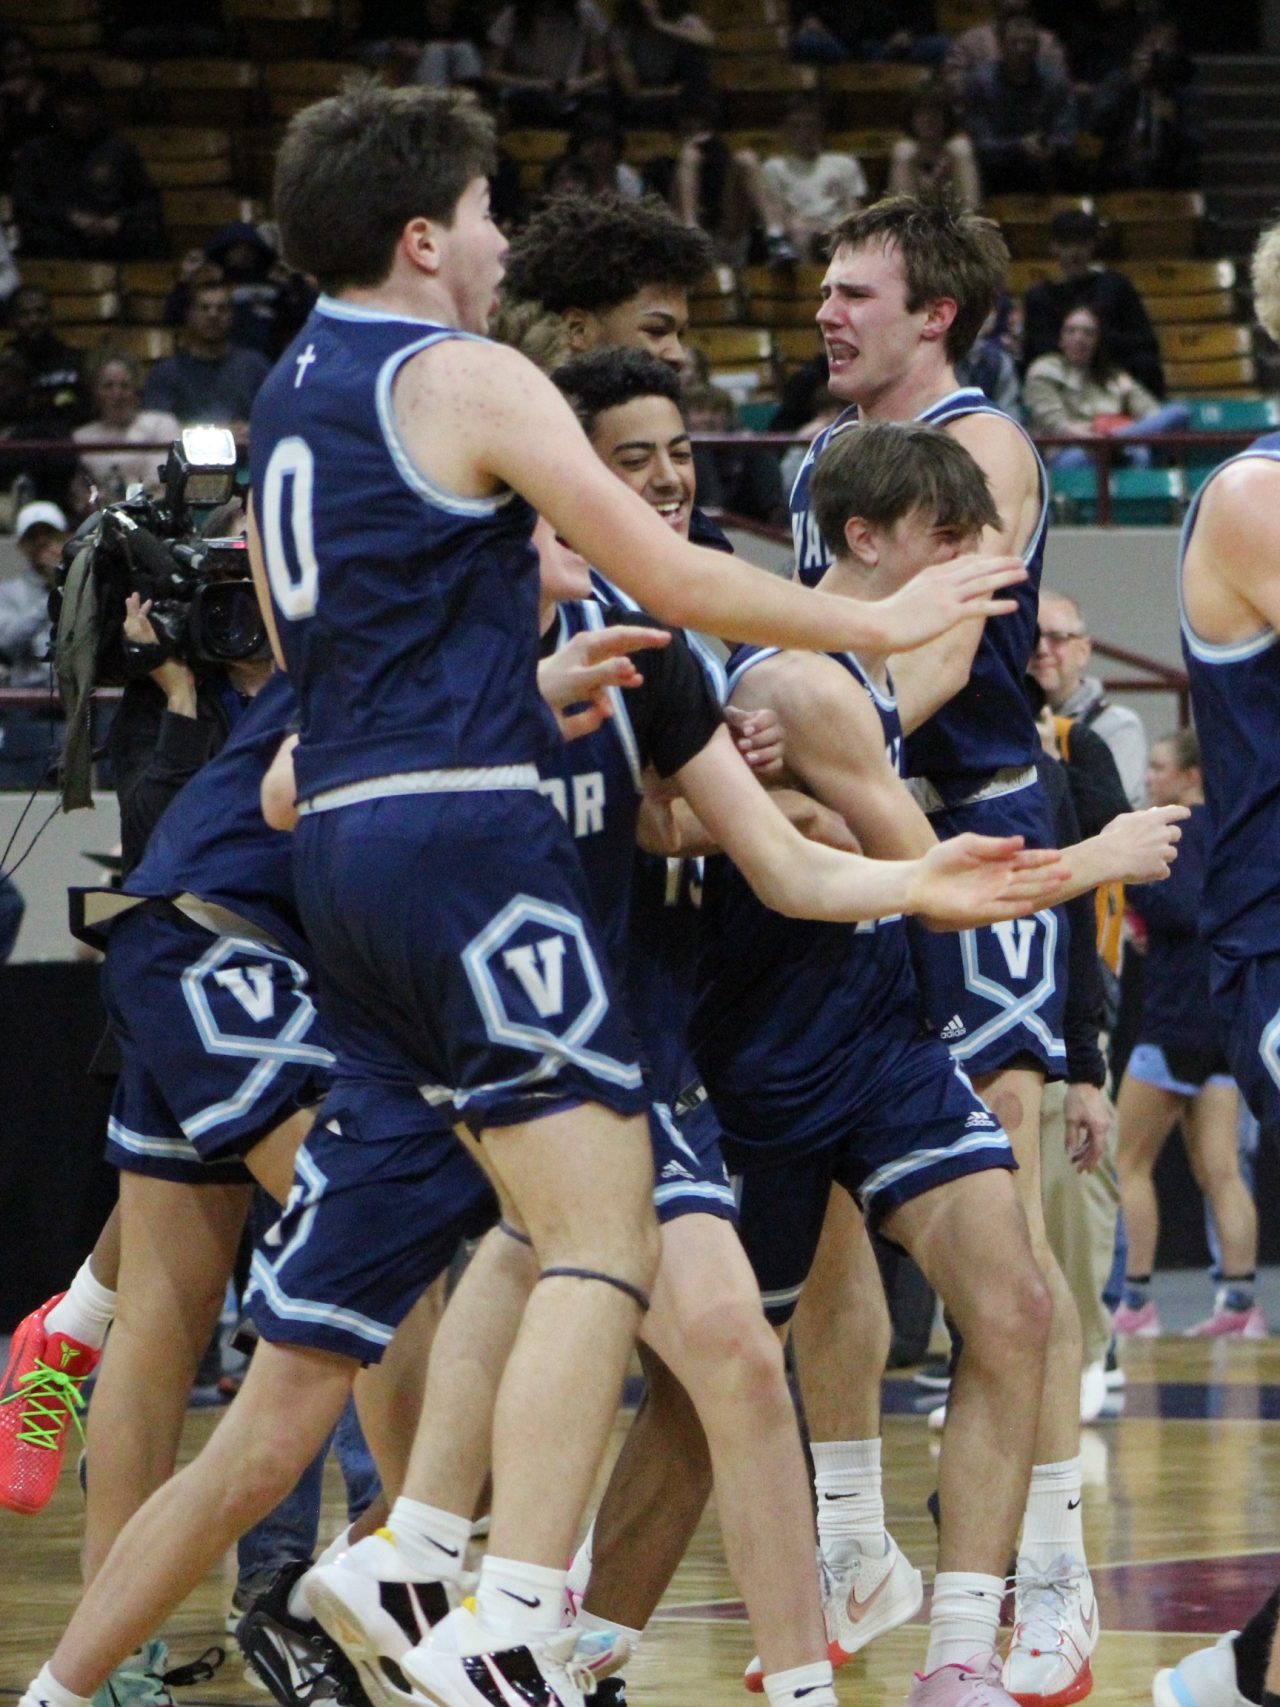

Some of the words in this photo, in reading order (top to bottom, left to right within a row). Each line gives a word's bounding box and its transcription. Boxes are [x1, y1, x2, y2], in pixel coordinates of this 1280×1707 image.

[504, 935, 567, 1018] V
[991, 918, 1037, 979] V
[214, 963, 274, 1023] V
